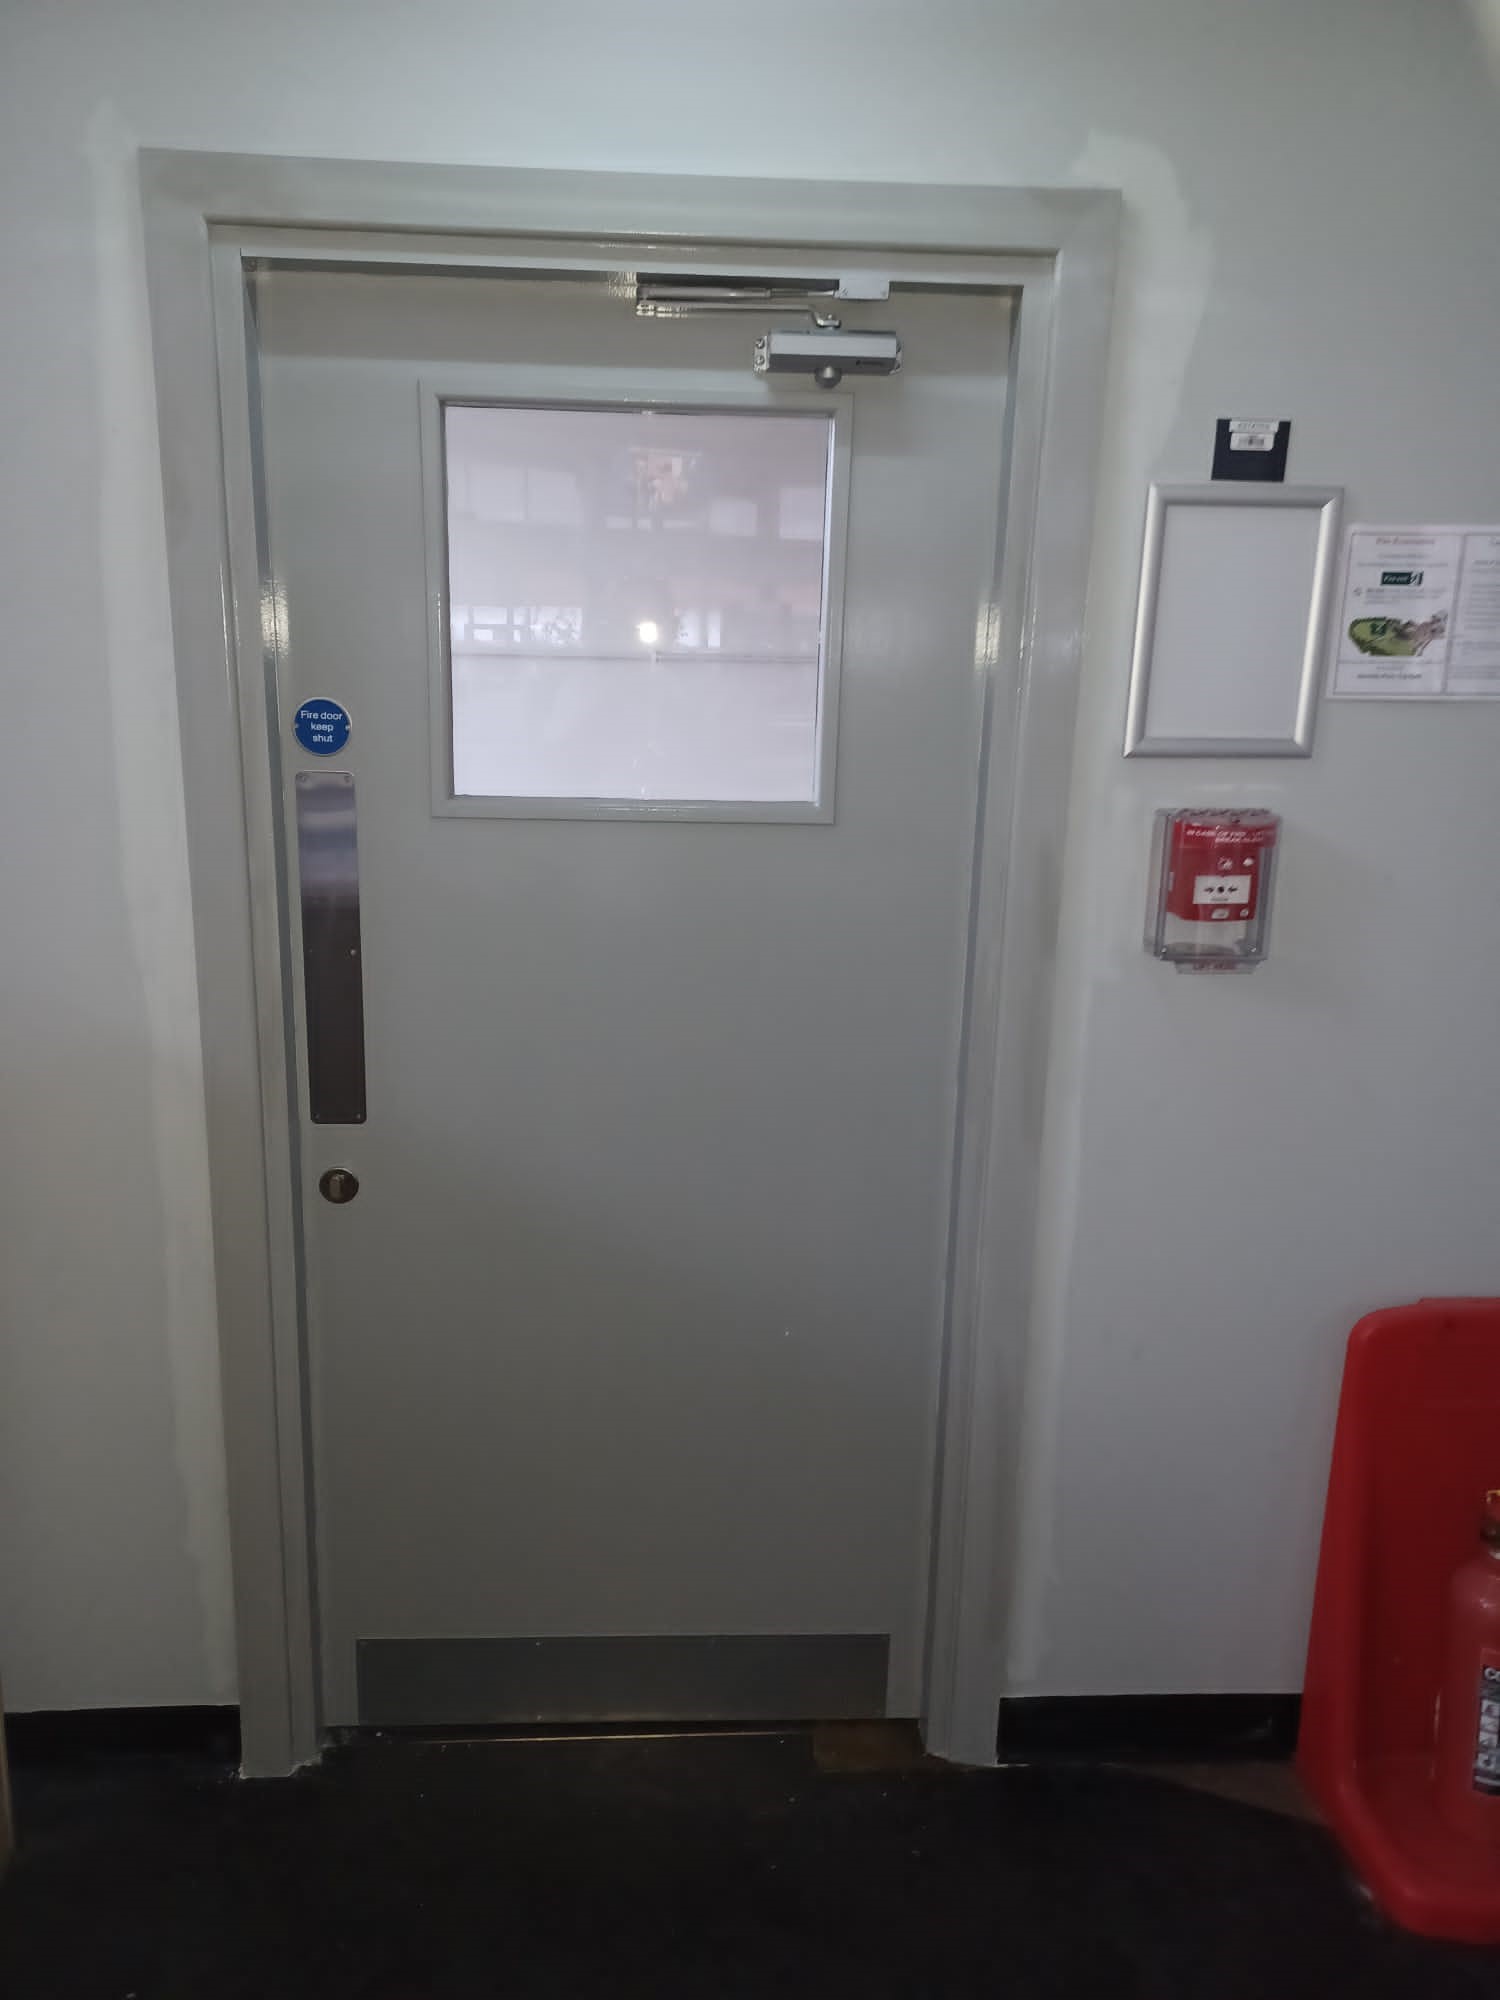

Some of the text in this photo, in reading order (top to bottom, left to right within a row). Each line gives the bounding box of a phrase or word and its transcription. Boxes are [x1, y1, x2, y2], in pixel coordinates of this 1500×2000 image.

[300, 710, 342, 720] Fire door
[310, 721, 334, 732] keep
[312, 734, 333, 743] shut
